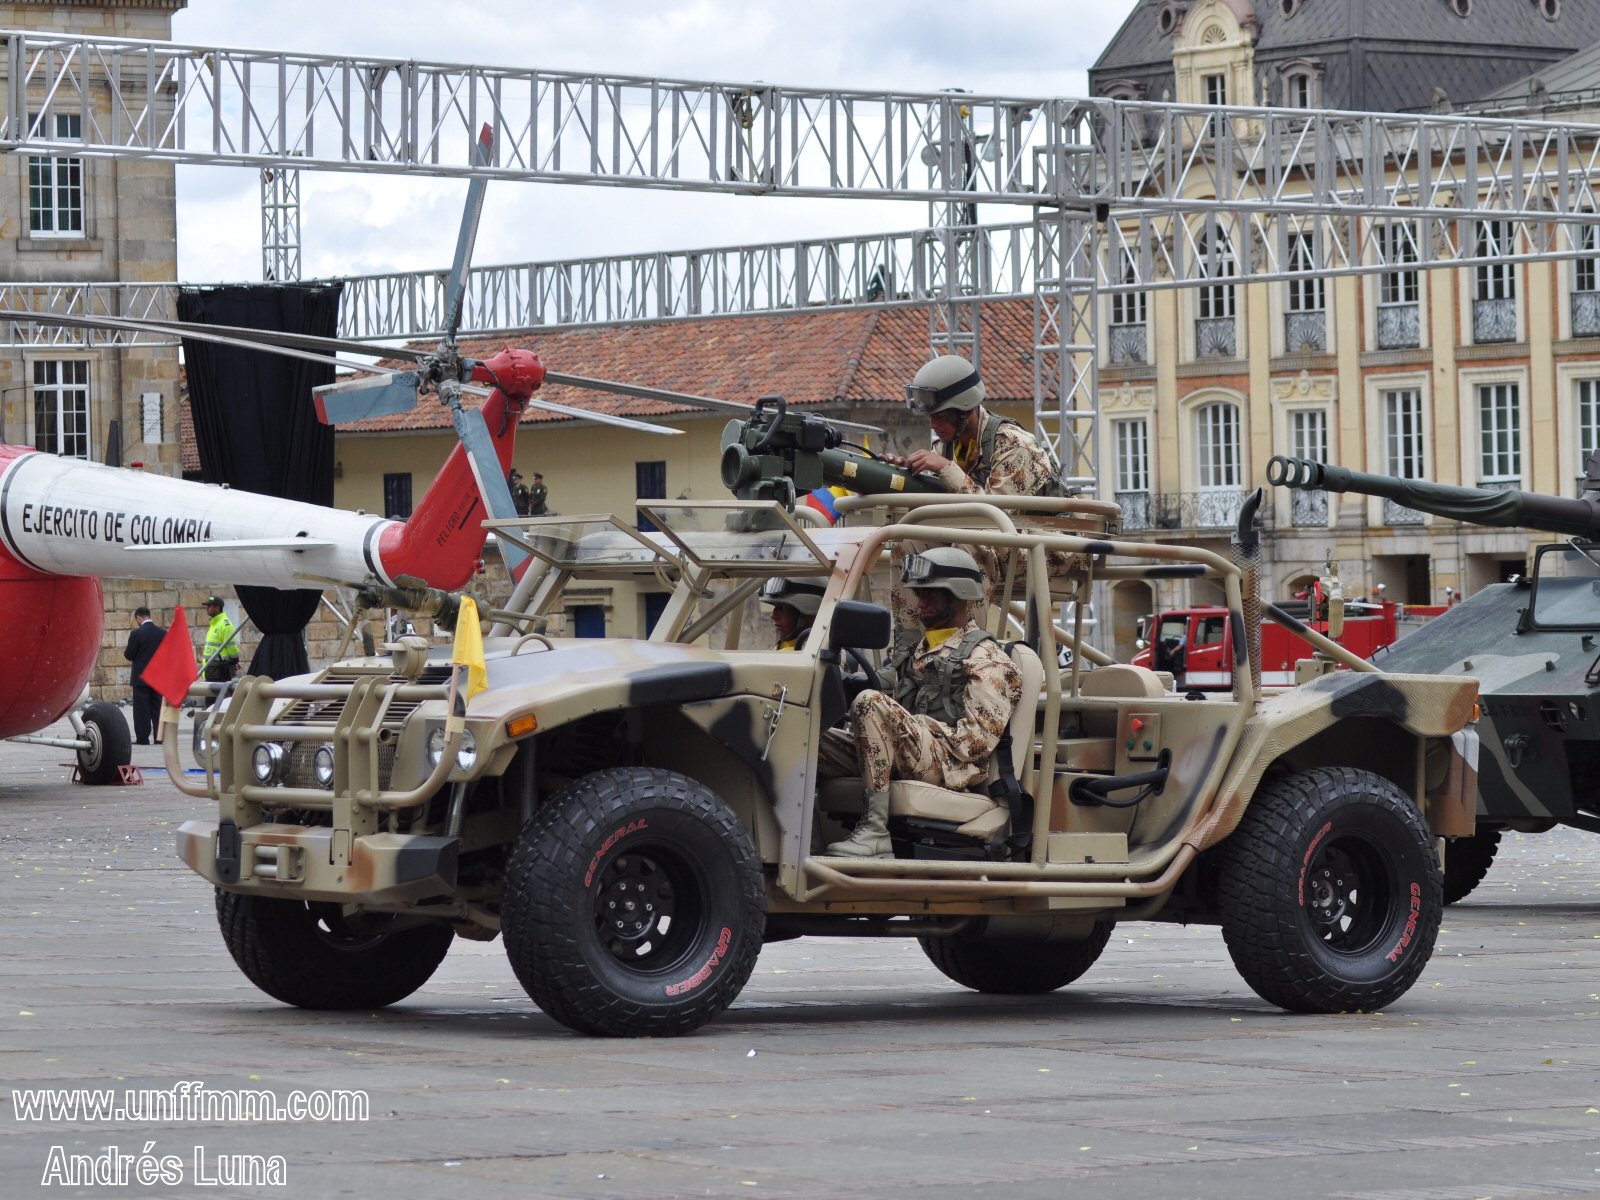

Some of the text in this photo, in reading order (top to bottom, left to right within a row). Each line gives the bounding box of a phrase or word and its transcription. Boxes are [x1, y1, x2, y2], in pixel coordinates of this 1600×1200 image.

[22, 504, 212, 544] EJERCITO DE COLOMBIA
[436, 511, 460, 548] PELIGRO
[584, 818, 648, 888] GENERAL
[1385, 882, 1421, 963] GENERAL
[666, 927, 732, 996] GRABBER
